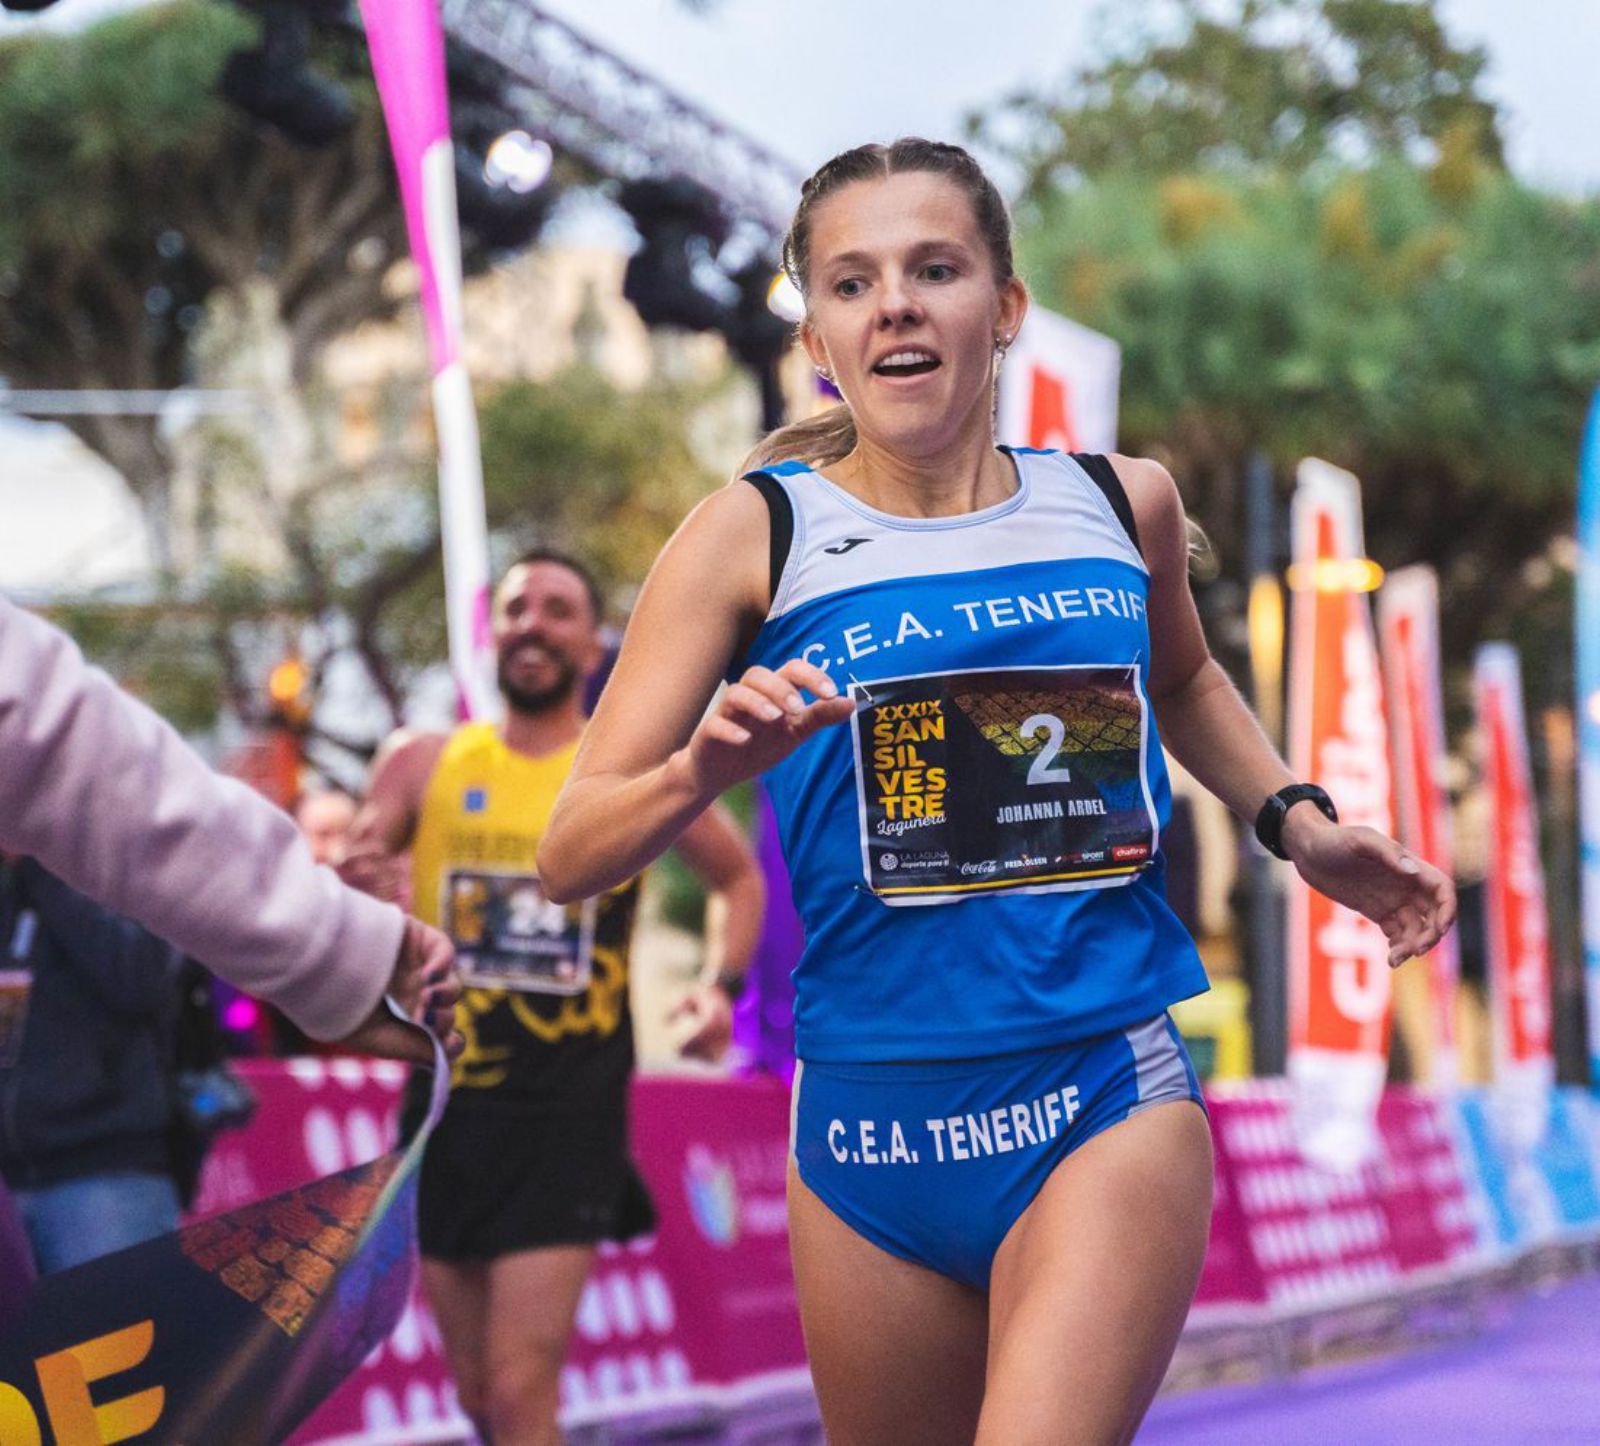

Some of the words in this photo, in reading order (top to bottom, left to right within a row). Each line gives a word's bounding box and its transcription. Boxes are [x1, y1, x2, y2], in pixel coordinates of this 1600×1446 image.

[802, 611, 944, 673] C.E.A.
[953, 587, 1148, 632] TENERIF
[874, 699, 943, 723] XXXIX
[873, 715, 946, 745] SAN
[873, 744, 927, 770] SIL
[1019, 713, 1071, 786] 2
[876, 767, 947, 796] VES
[879, 793, 945, 820] TRE
[996, 801, 1064, 824] JOHANNA
[876, 813, 947, 837] Lagunera
[827, 1118, 920, 1164] C.E.A.
